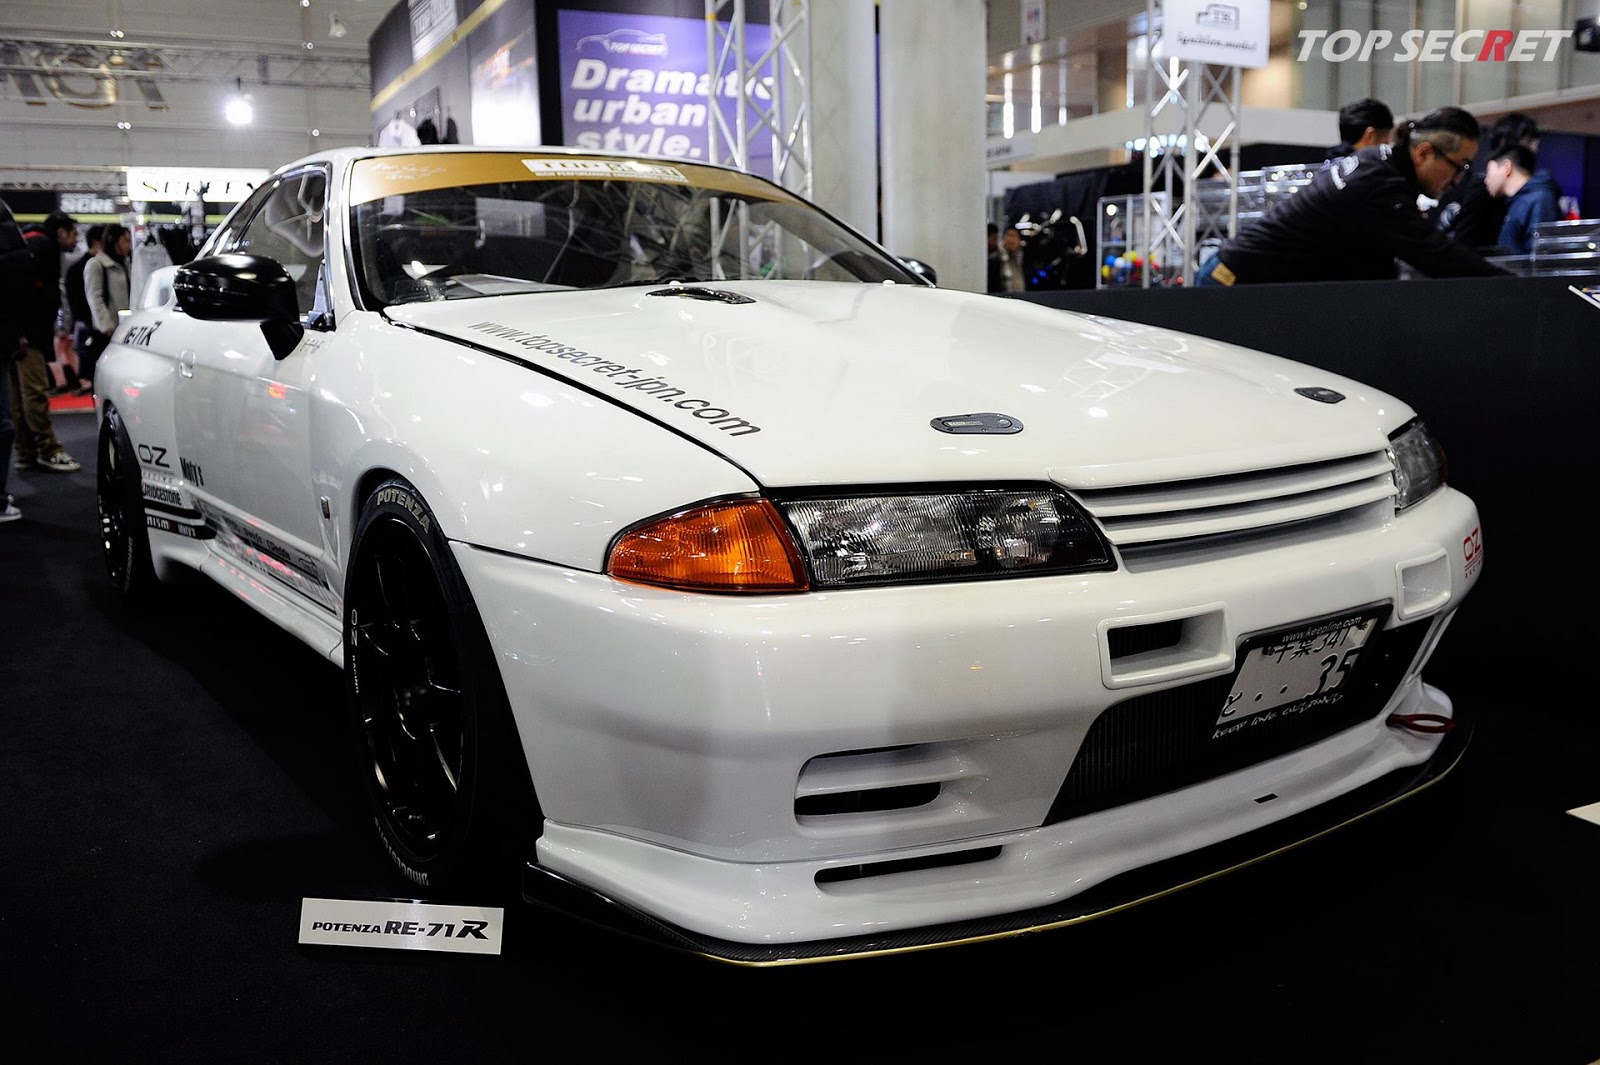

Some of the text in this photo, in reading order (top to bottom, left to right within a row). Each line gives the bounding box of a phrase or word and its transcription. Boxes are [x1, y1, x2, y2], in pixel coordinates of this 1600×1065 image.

[573, 94, 706, 127] urban
[577, 127, 701, 158] style.
[467, 321, 761, 438] www.topsecret-jpn.com
[377, 488, 430, 534] POTENZA
[1282, 616, 1362, 643] www.keepline.com
[312, 922, 381, 934] POTENZA
